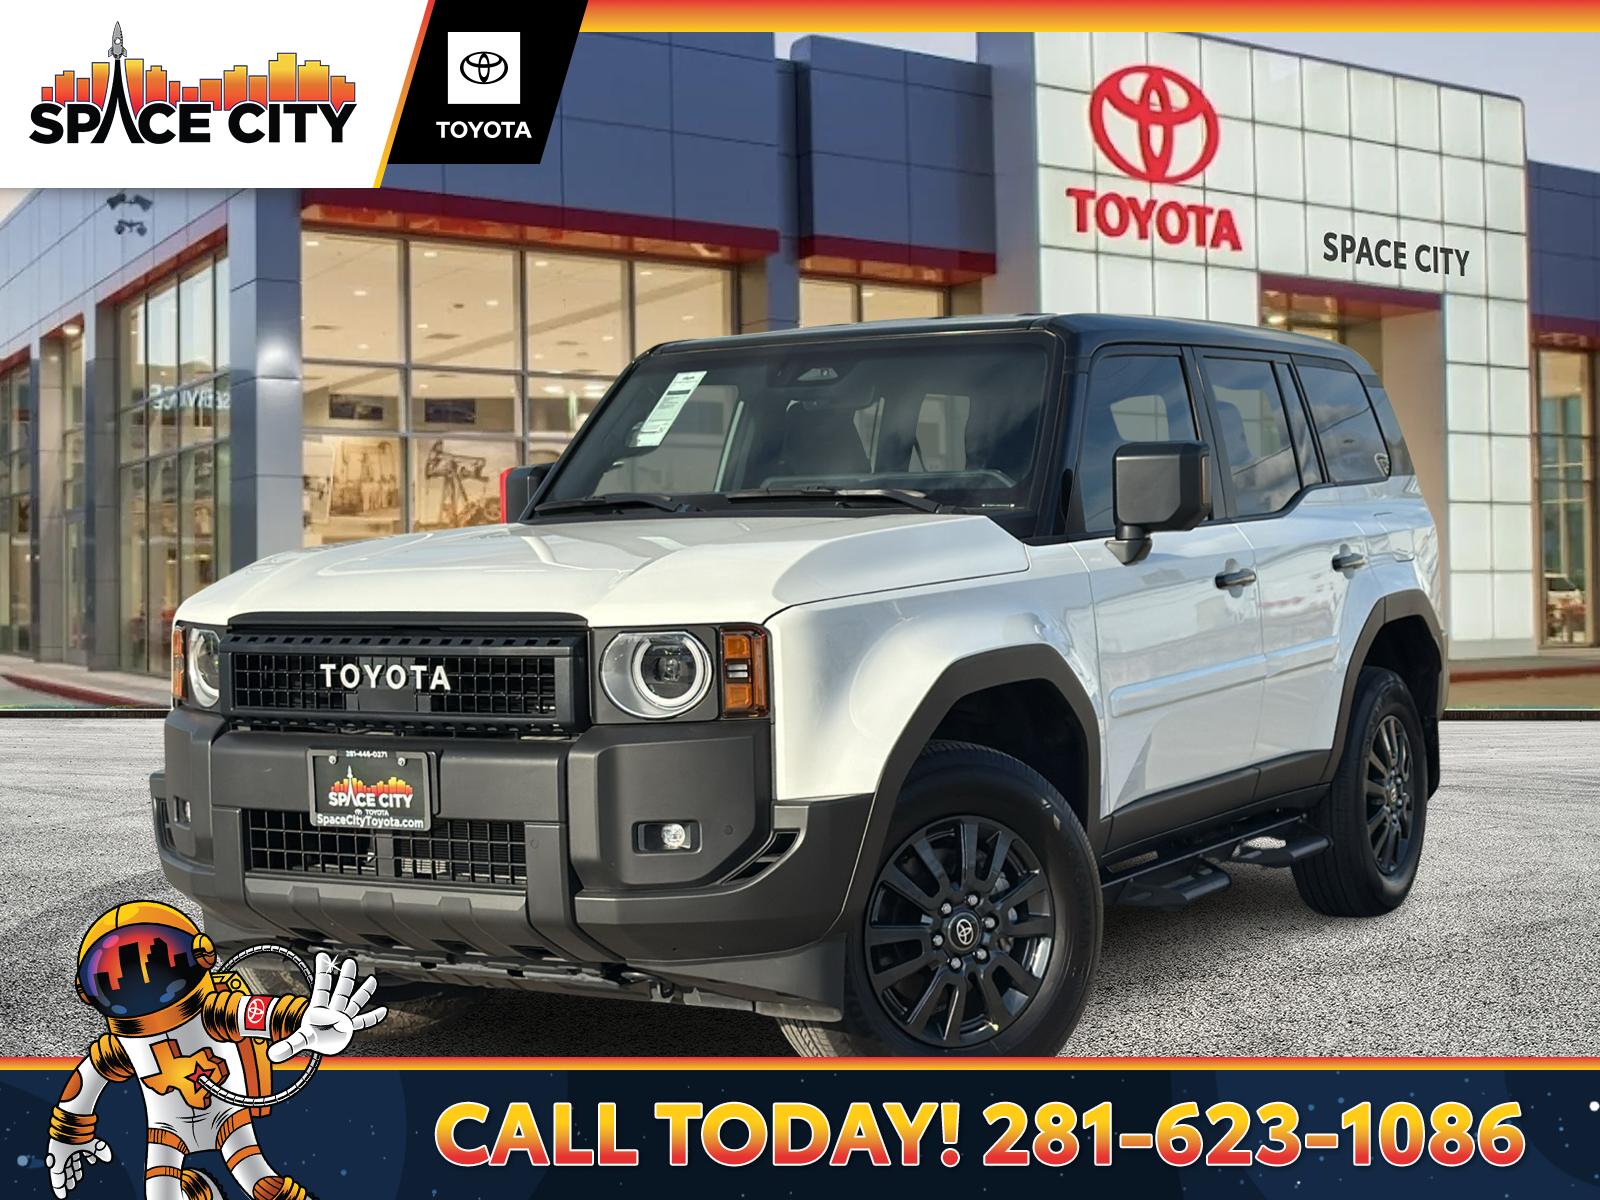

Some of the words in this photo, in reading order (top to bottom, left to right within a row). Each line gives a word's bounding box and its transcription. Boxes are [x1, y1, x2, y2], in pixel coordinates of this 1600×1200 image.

[1066, 187, 1242, 251] TOYOTA
[1323, 232, 1406, 269] SPACE
[1414, 244, 1470, 276] CITY
[320, 663, 451, 690] TOYOTA
[378, 793, 413, 808] CITY
[317, 814, 424, 828] SpaceCityToyota.com
